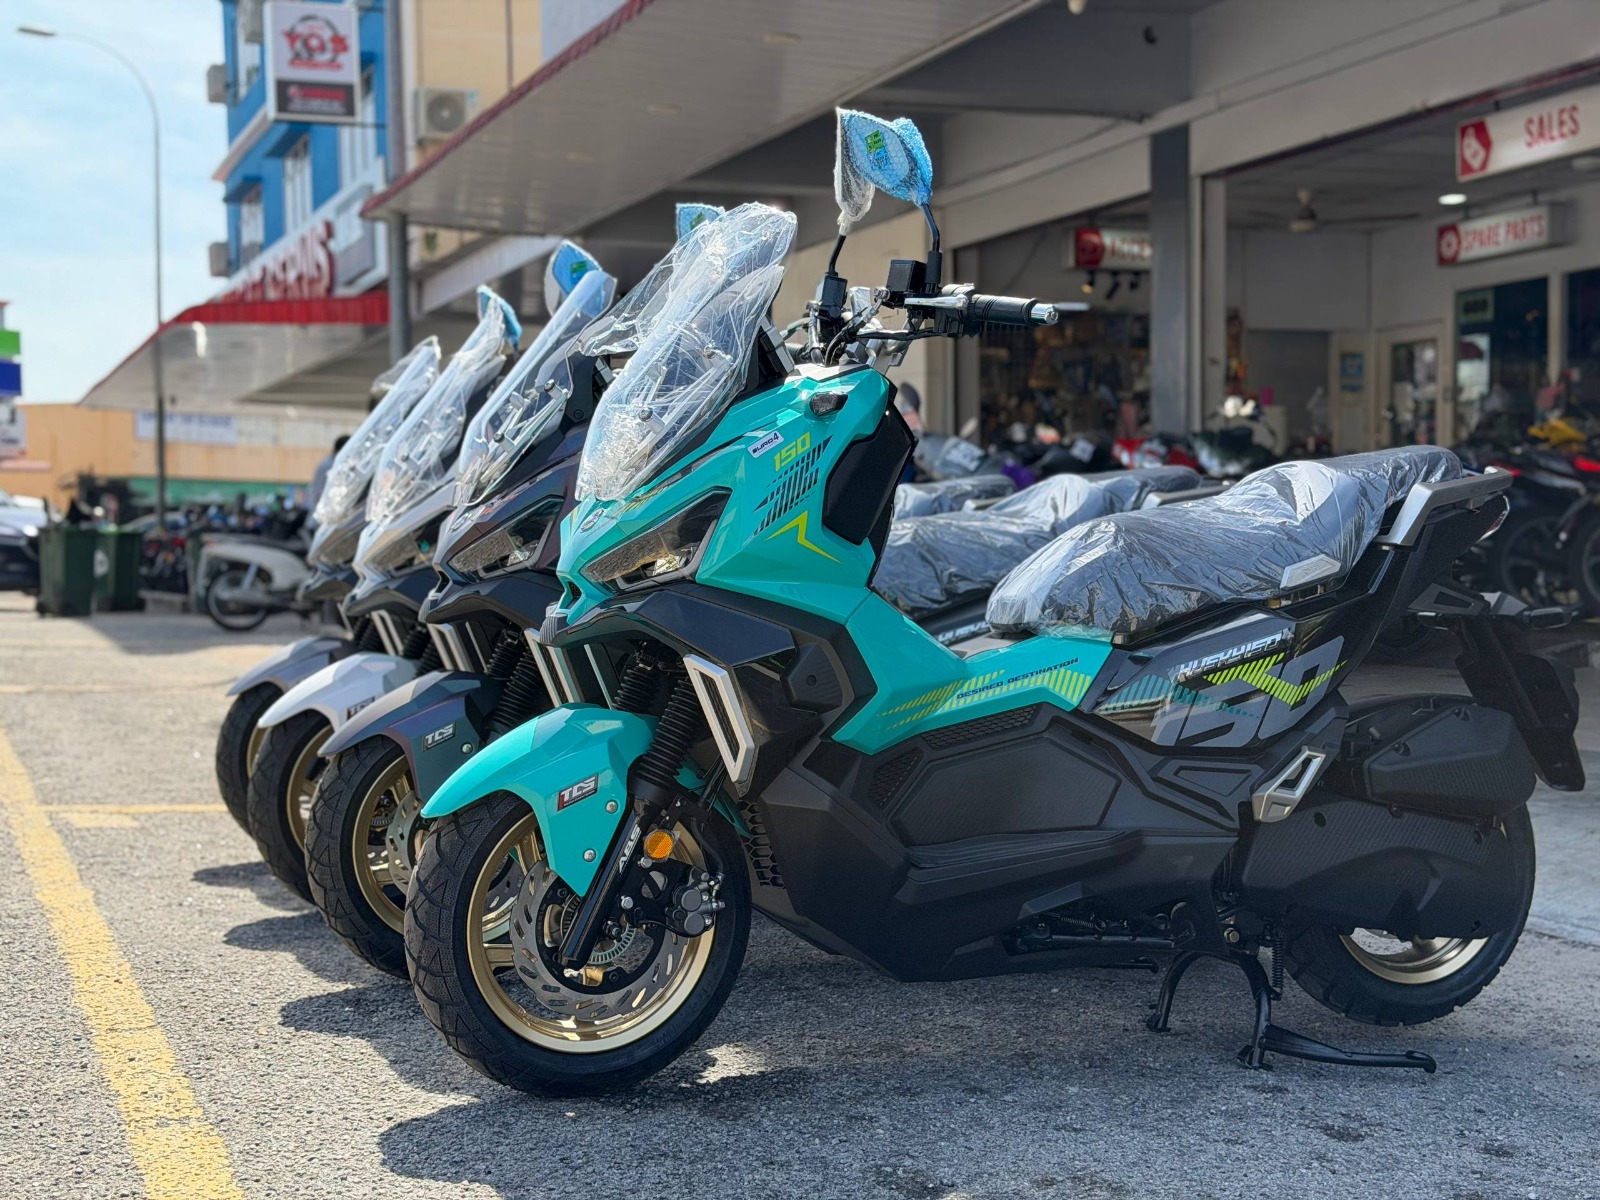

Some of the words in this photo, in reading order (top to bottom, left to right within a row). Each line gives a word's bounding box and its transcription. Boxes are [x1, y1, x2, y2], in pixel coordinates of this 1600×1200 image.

[1525, 104, 1579, 148] SALES
[1463, 224, 1501, 253] SPARE
[1506, 214, 1546, 241] PARTS
[774, 431, 811, 472] 150
[957, 681, 1003, 699] DESIRED
[1008, 657, 1079, 683] DESTINATION
[1150, 635, 1345, 748] 150
[425, 723, 453, 745] TCS
[561, 776, 596, 802] TCS
[619, 823, 642, 874] ABS
